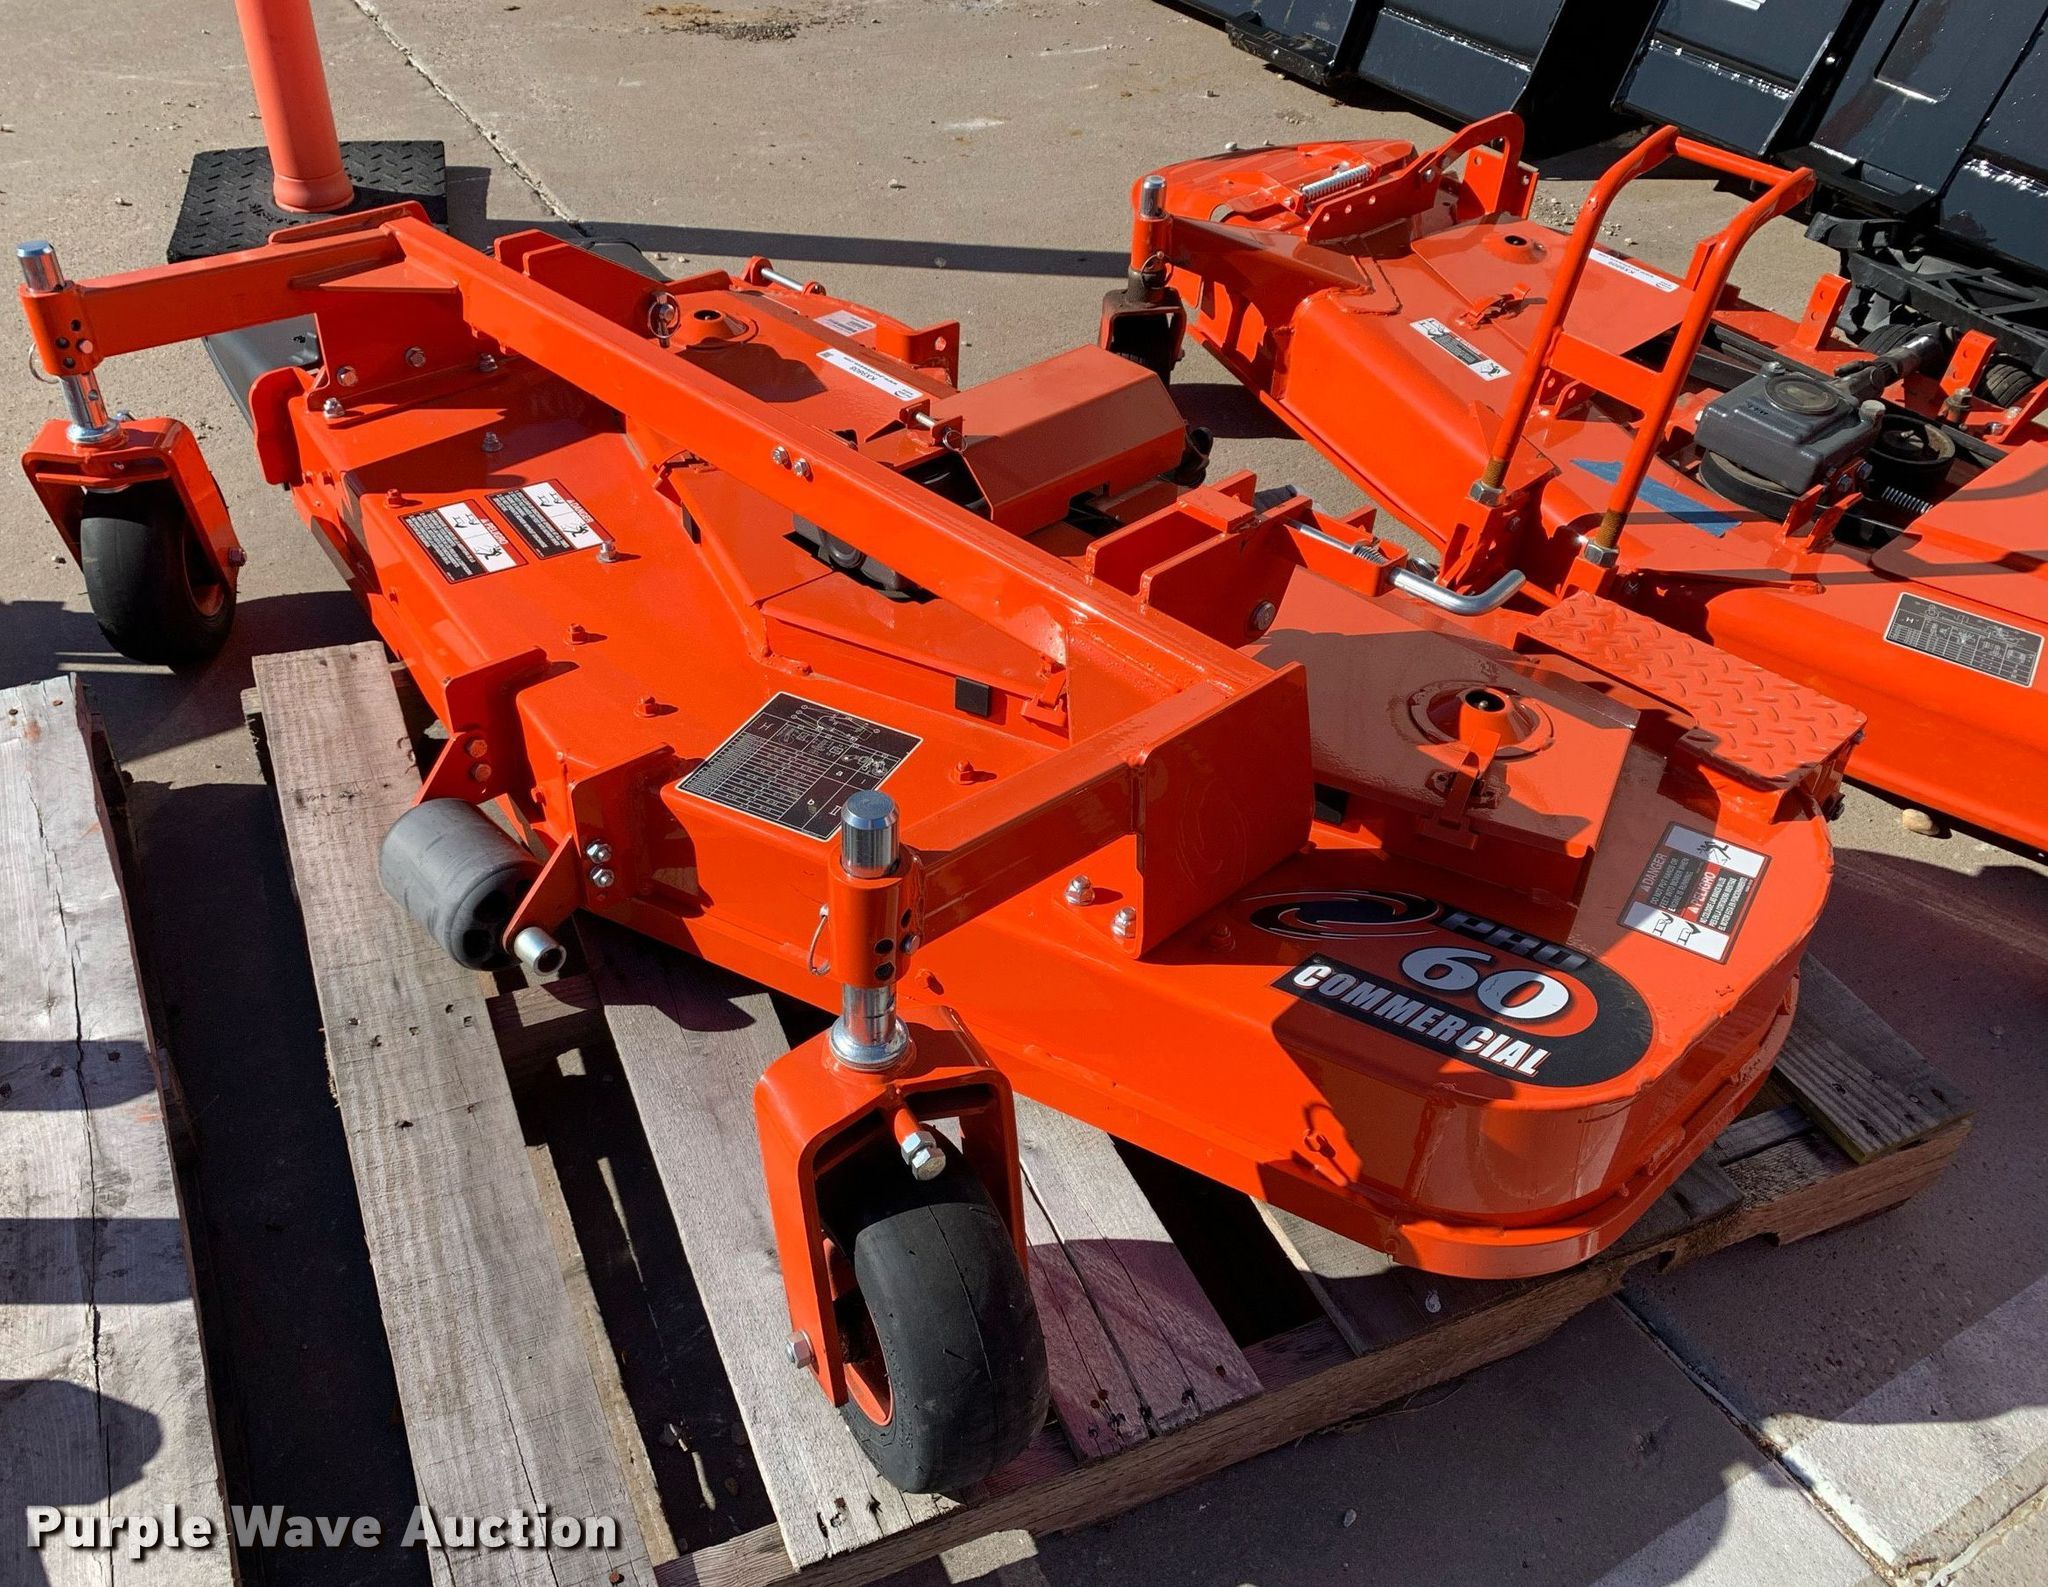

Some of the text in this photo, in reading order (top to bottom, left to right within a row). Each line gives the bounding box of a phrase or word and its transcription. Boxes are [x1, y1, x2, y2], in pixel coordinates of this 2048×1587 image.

[568, 501, 595, 523] DANGER
[483, 521, 509, 545] PELIGRO
[1641, 852, 1668, 886] DANGER
[1690, 870, 1717, 907] PELIGRO
[1437, 911, 1589, 971] PRO
[1401, 947, 1571, 1020] 60
[1292, 964, 1551, 1077] COMMERCIAL
